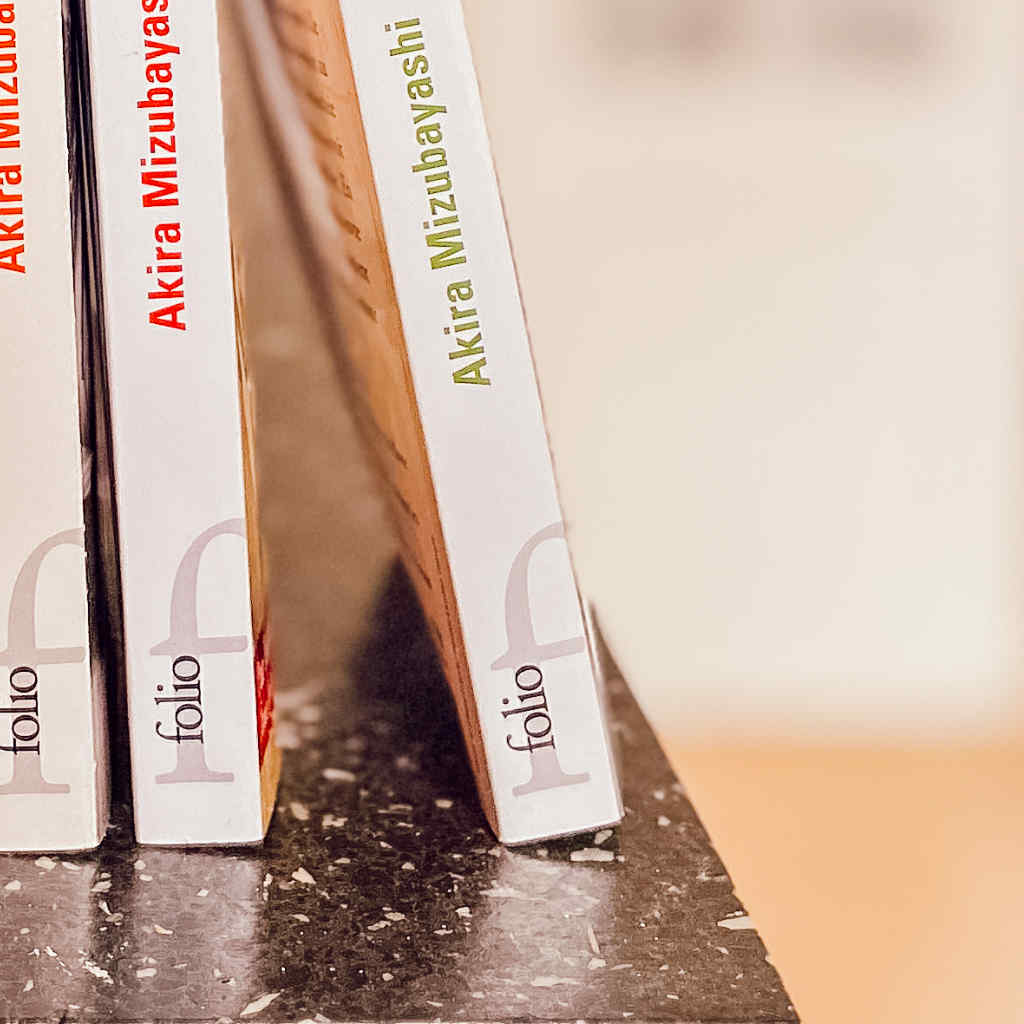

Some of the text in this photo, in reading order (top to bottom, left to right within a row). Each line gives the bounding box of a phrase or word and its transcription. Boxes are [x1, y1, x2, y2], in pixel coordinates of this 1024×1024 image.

[383, 16, 492, 387] Akira Mizubayashi
[145, 222, 187, 332] Akira
[153, 654, 202, 744] folio
[501, 663, 556, 754] folio
